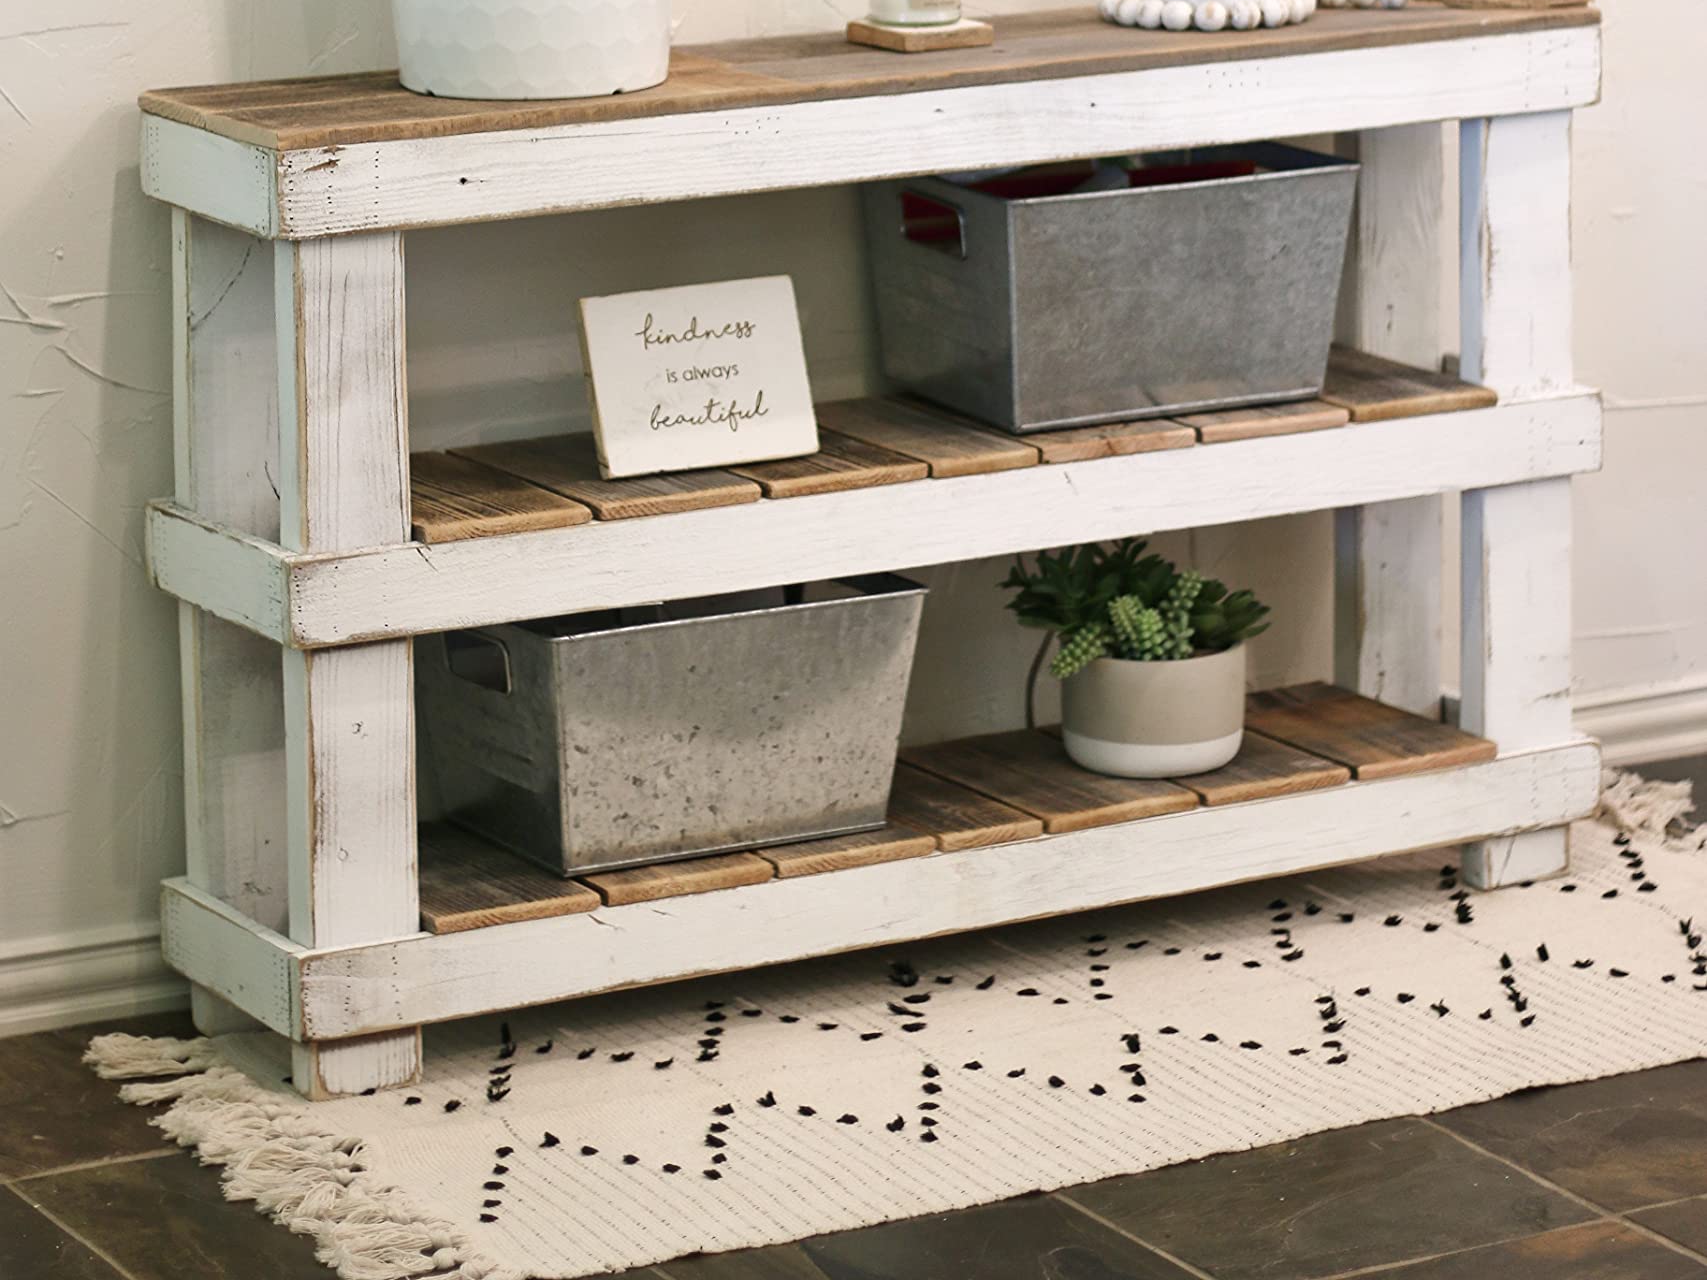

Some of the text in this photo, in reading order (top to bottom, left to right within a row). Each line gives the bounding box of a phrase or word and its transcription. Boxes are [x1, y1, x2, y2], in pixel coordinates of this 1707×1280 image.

[635, 313, 756, 349] kindness
[666, 363, 739, 383] is always
[650, 390, 769, 431] beautiful
